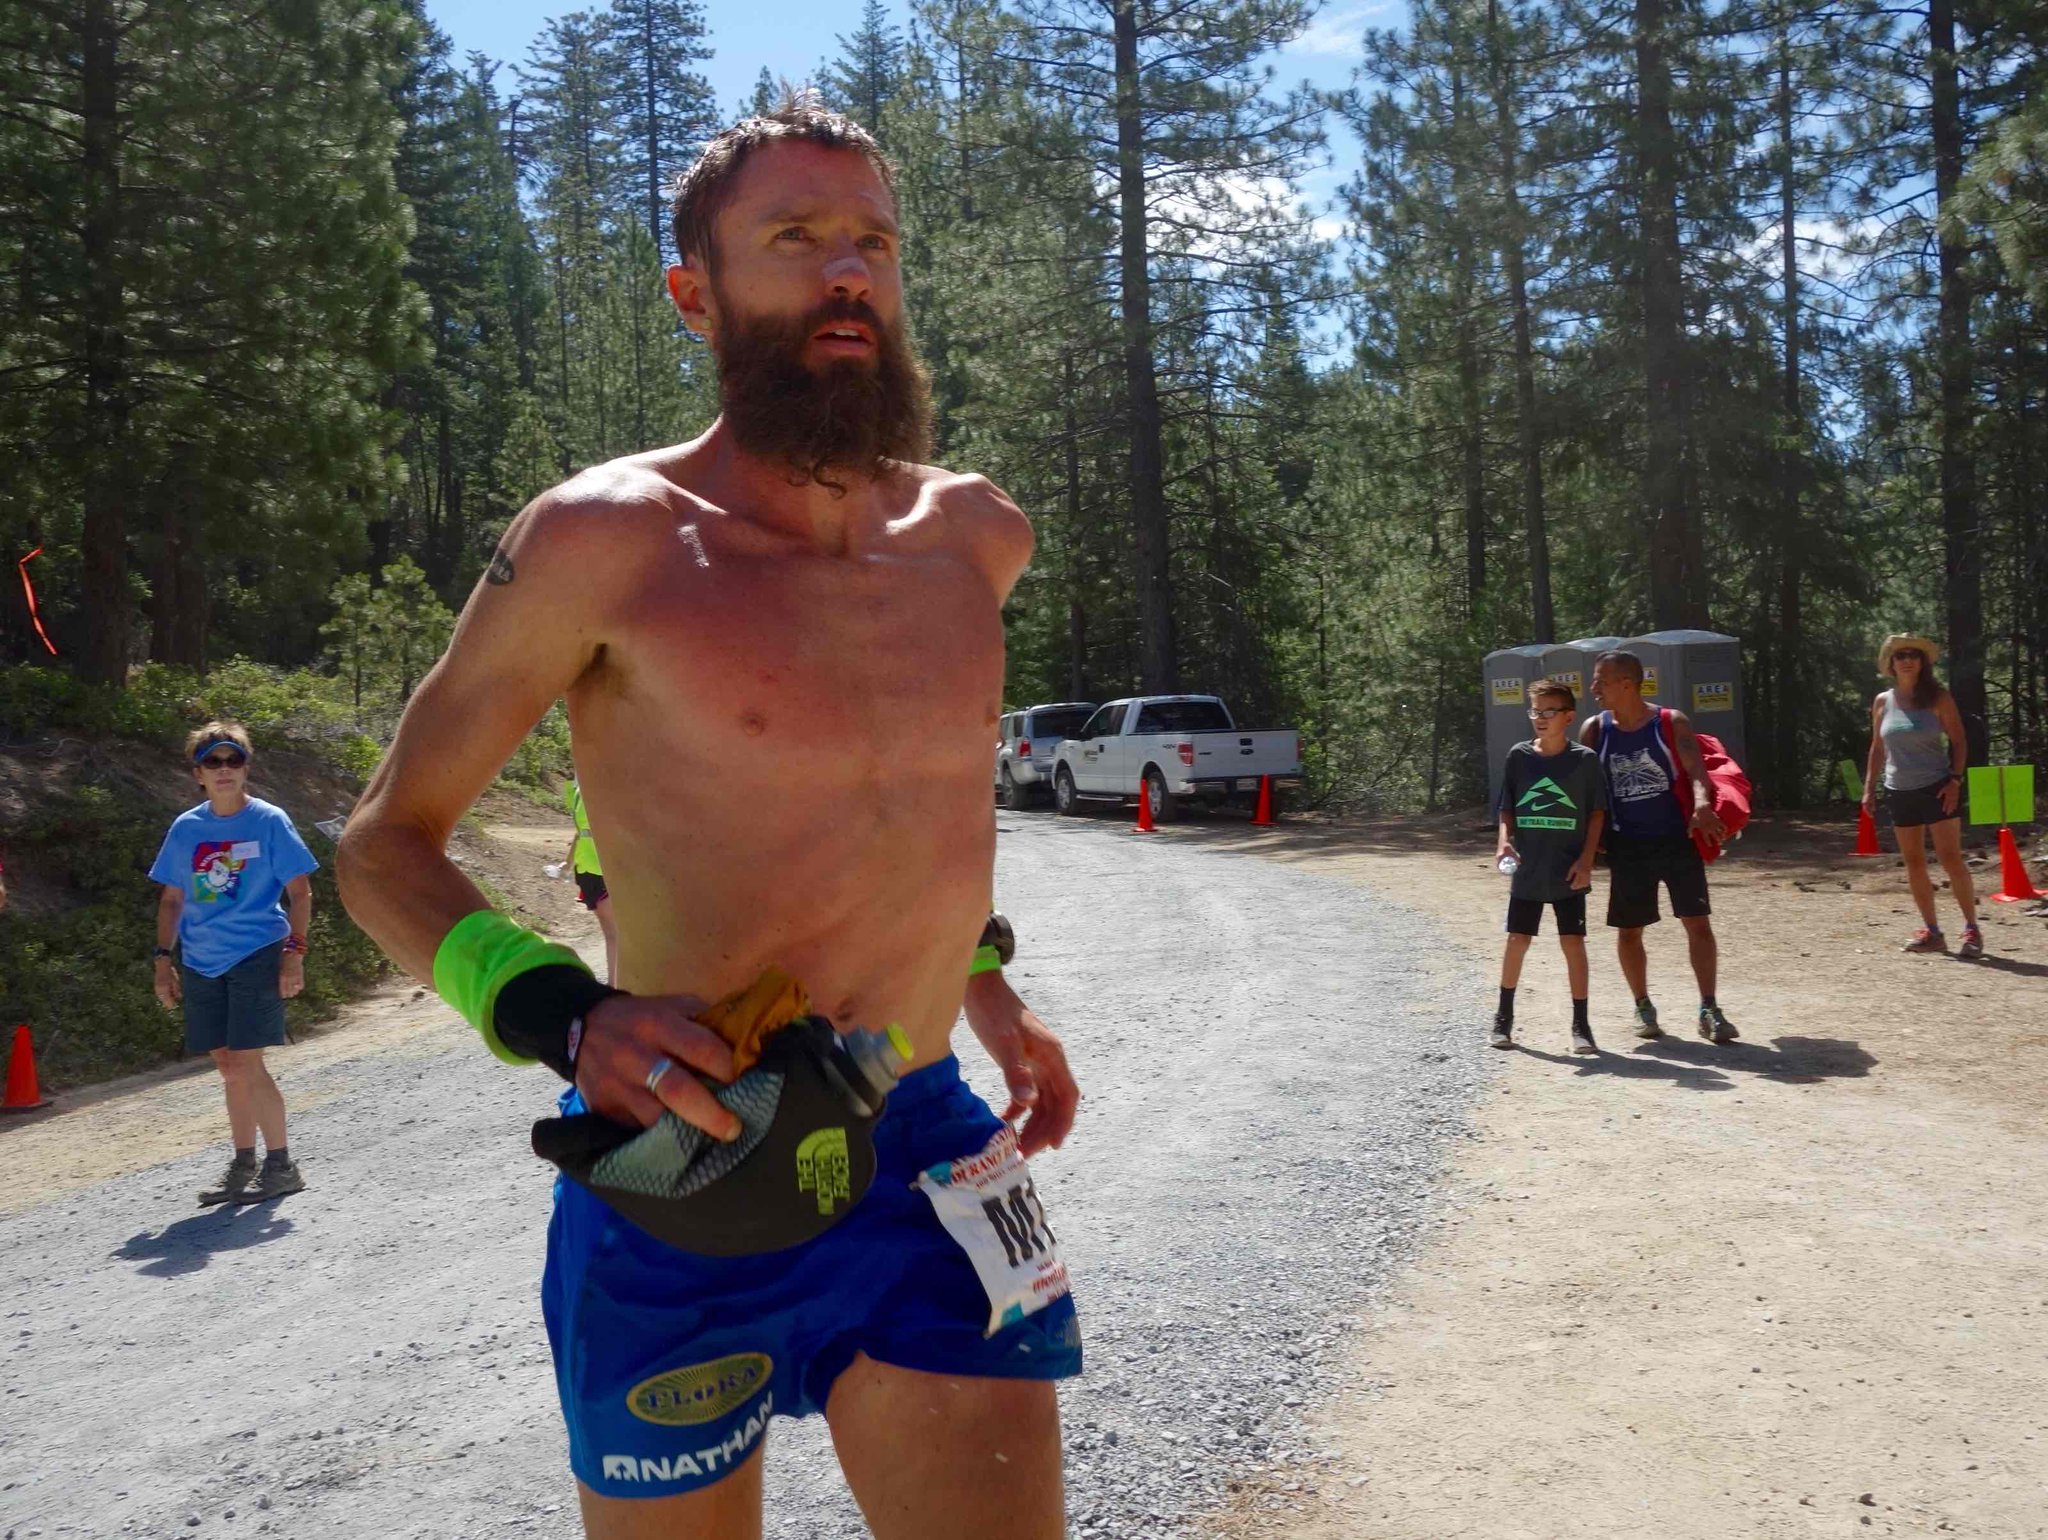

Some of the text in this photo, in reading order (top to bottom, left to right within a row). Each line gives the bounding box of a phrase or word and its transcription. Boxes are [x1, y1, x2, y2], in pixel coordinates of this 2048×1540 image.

[1495, 680, 1520, 688] AREA
[1698, 684, 1729, 694] AREA
[640, 1390, 773, 1483] NATHAN
